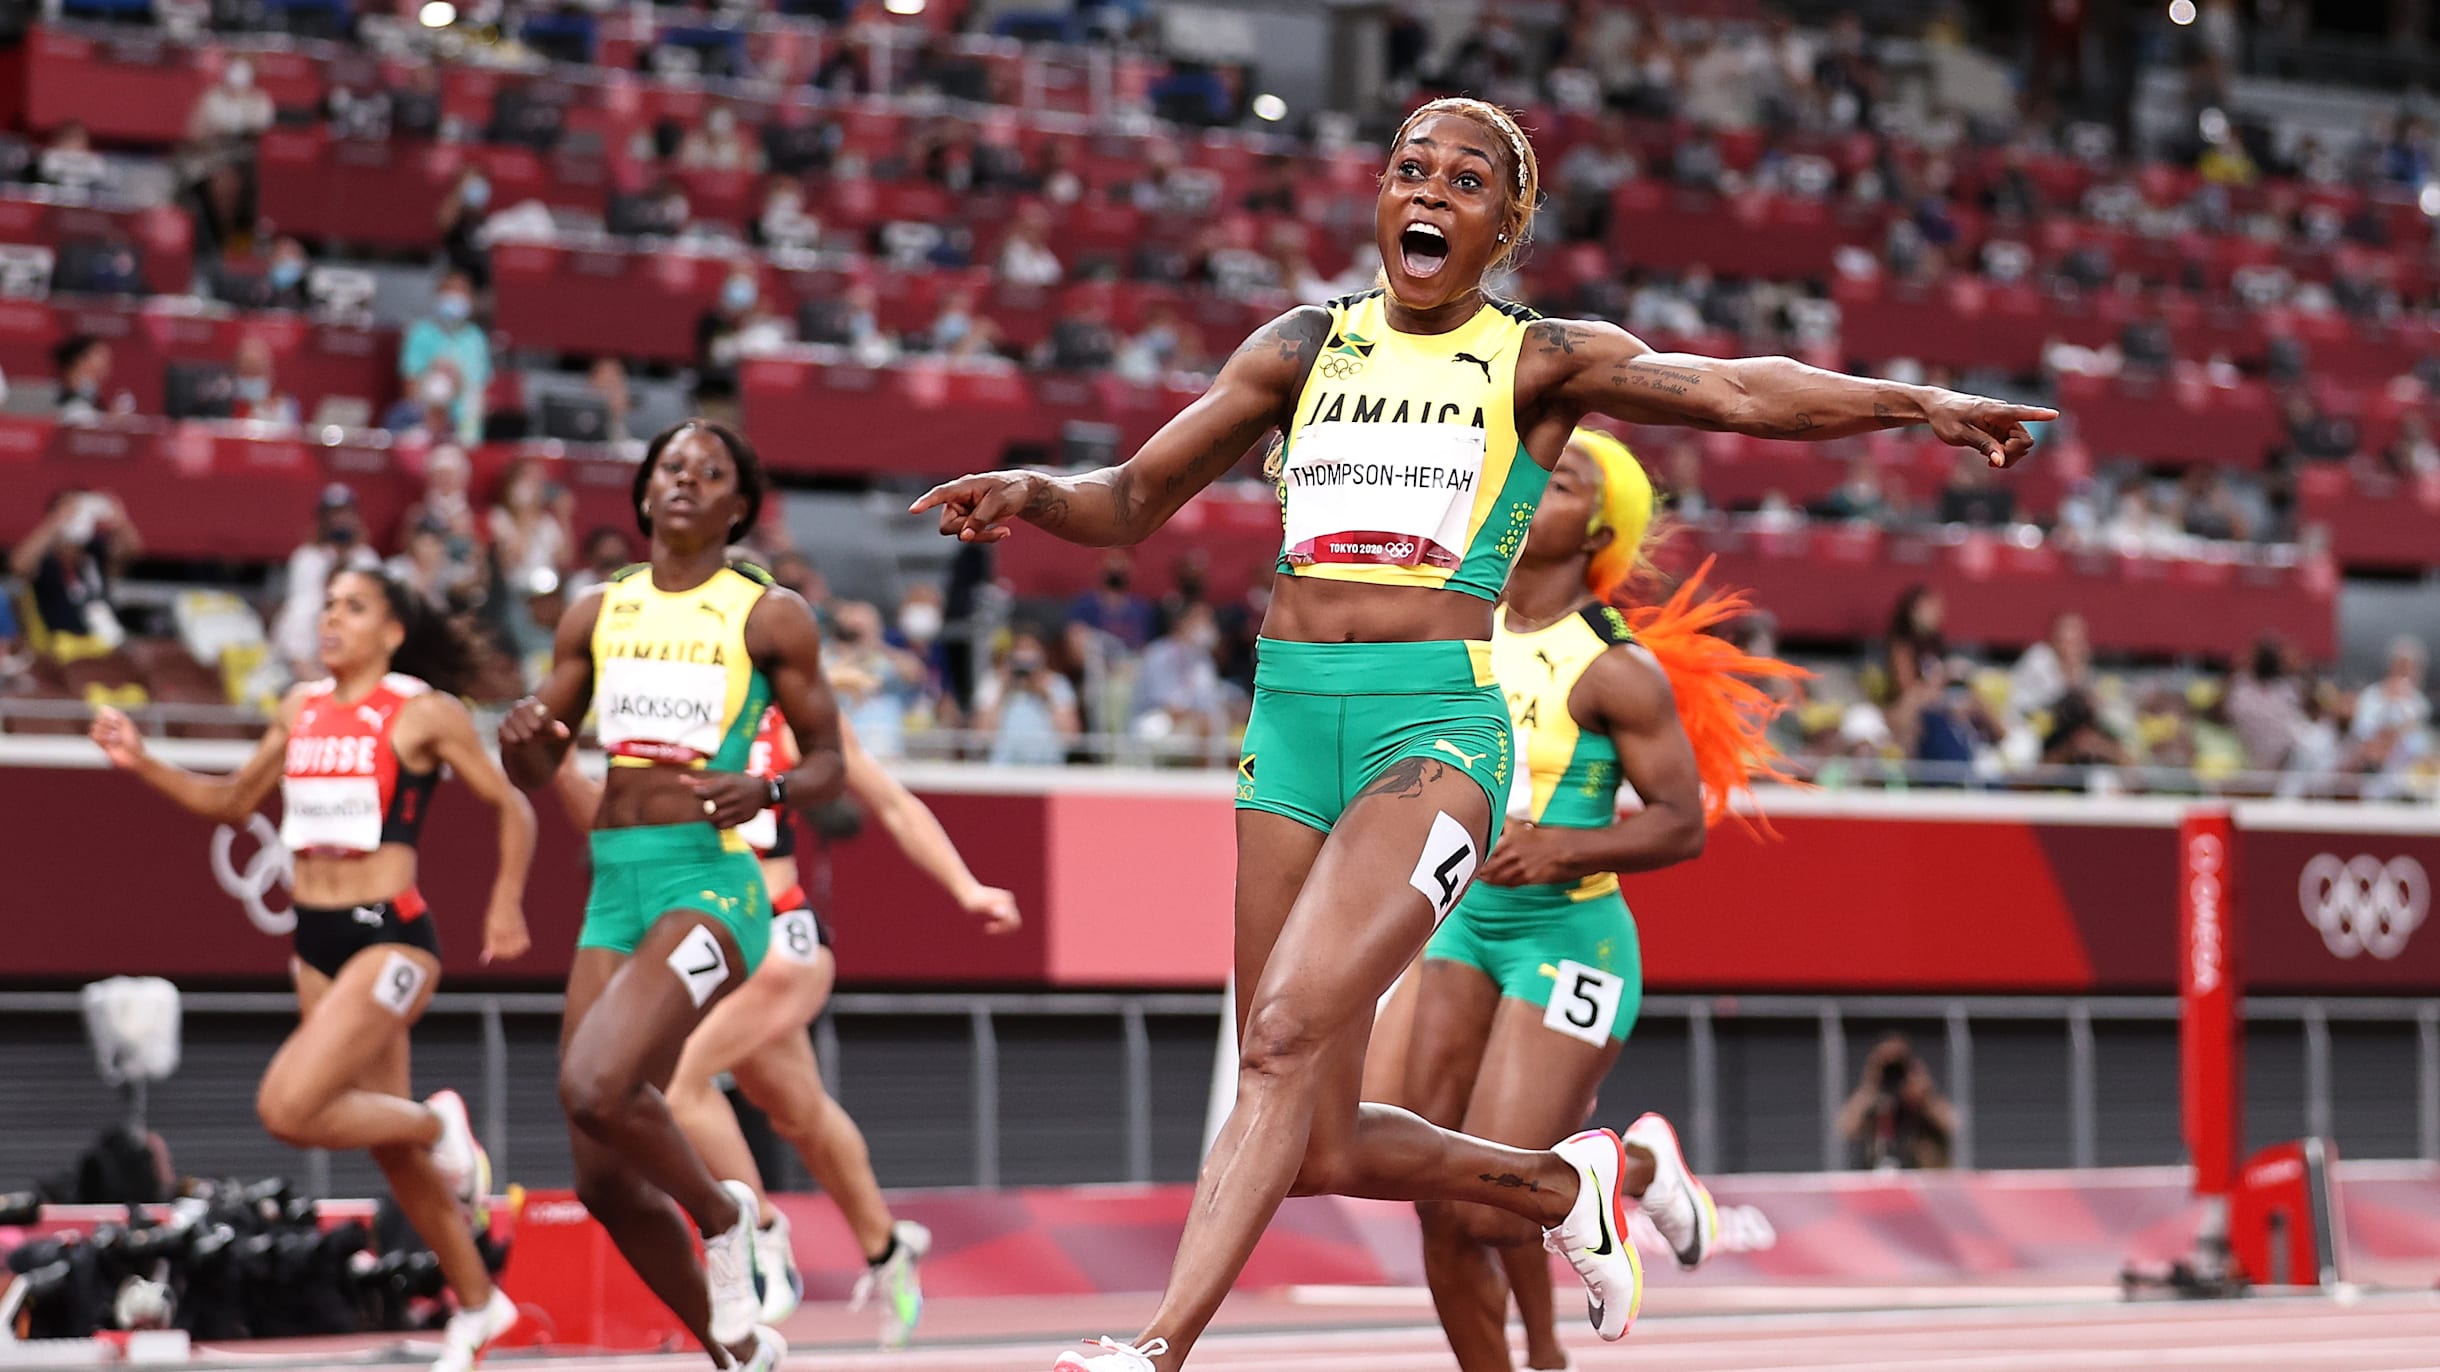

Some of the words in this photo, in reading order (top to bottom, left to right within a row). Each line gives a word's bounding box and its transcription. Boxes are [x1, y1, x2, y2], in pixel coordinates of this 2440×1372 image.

[1290, 463, 1474, 492] THOMPSON-HERAH
[1329, 543, 1359, 554] TOKYO
[1360, 545, 1383, 554] 2020
[610, 694, 712, 722] JACKSON
[1433, 843, 1471, 911] 4
[786, 919, 811, 956] 8
[688, 941, 721, 976] 7
[391, 965, 415, 1003] 9
[1565, 972, 1602, 1029] 5
